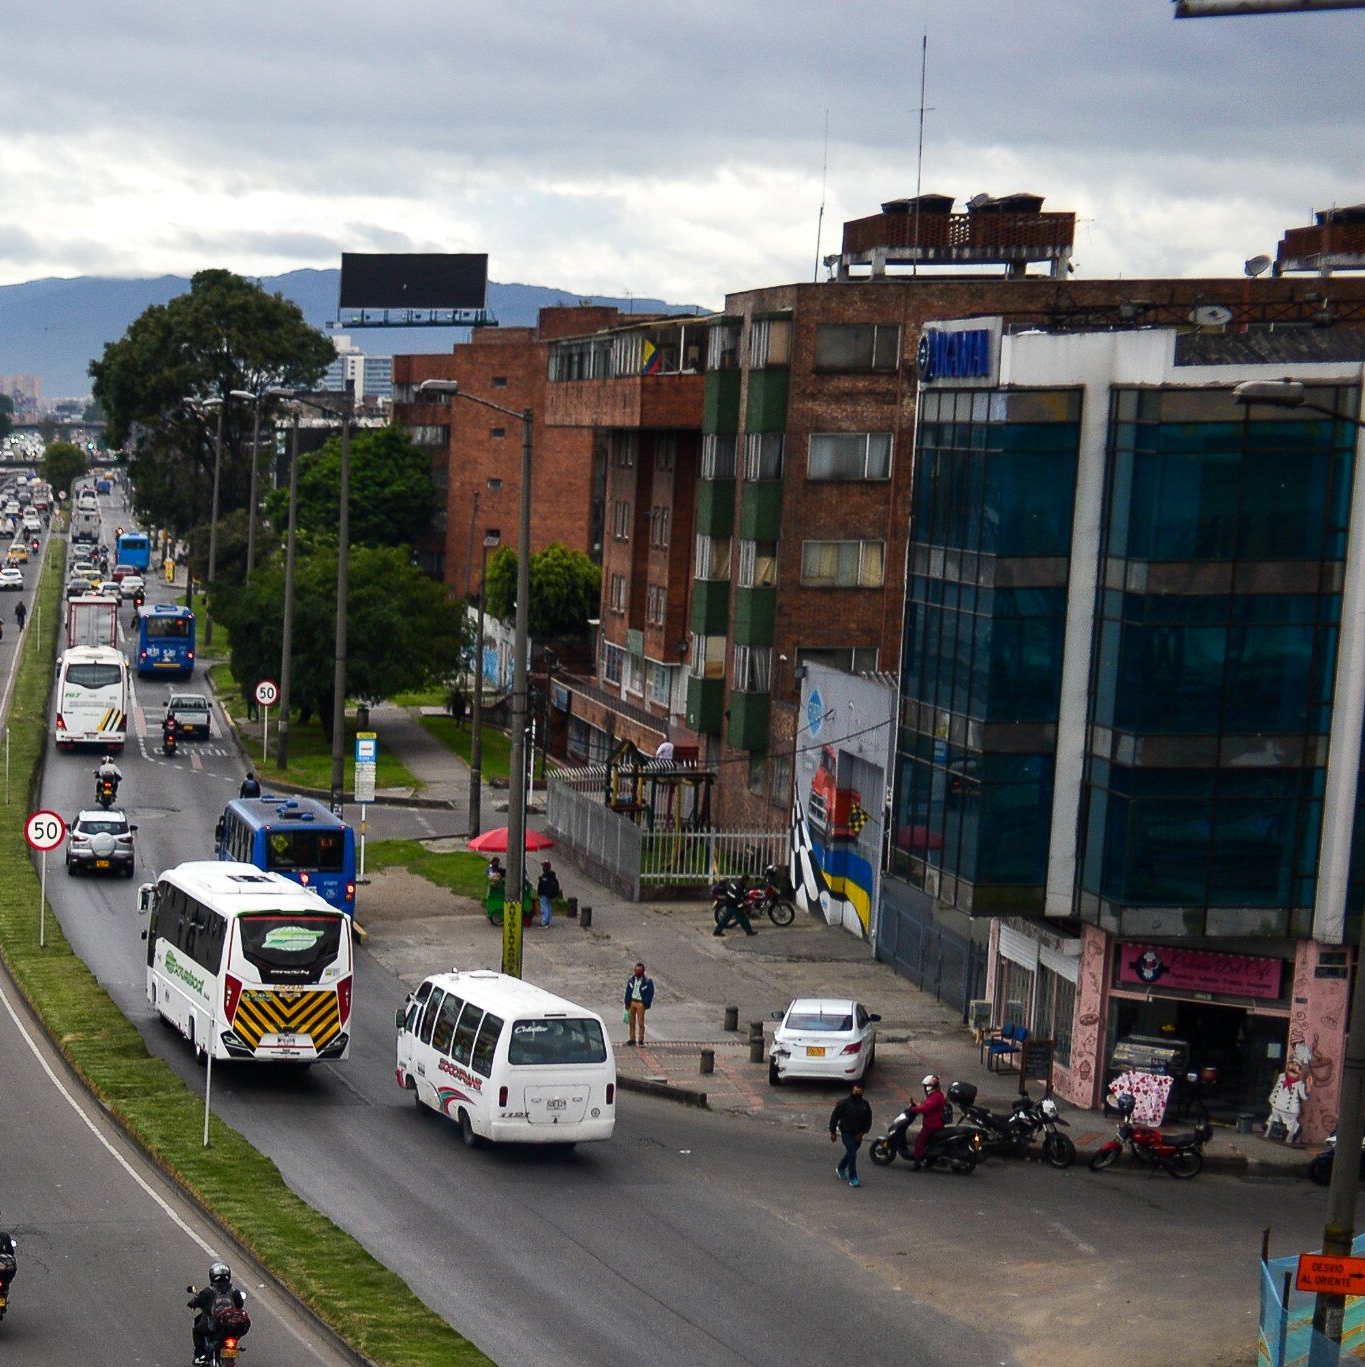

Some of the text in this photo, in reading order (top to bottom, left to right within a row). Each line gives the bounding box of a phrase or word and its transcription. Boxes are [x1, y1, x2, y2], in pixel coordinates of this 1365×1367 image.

[260, 687, 274, 699] 50
[34, 822, 58, 840] 50
[1312, 1262, 1345, 1273] DESVIO
[1301, 1275, 1352, 1288] AL ORIENTE
